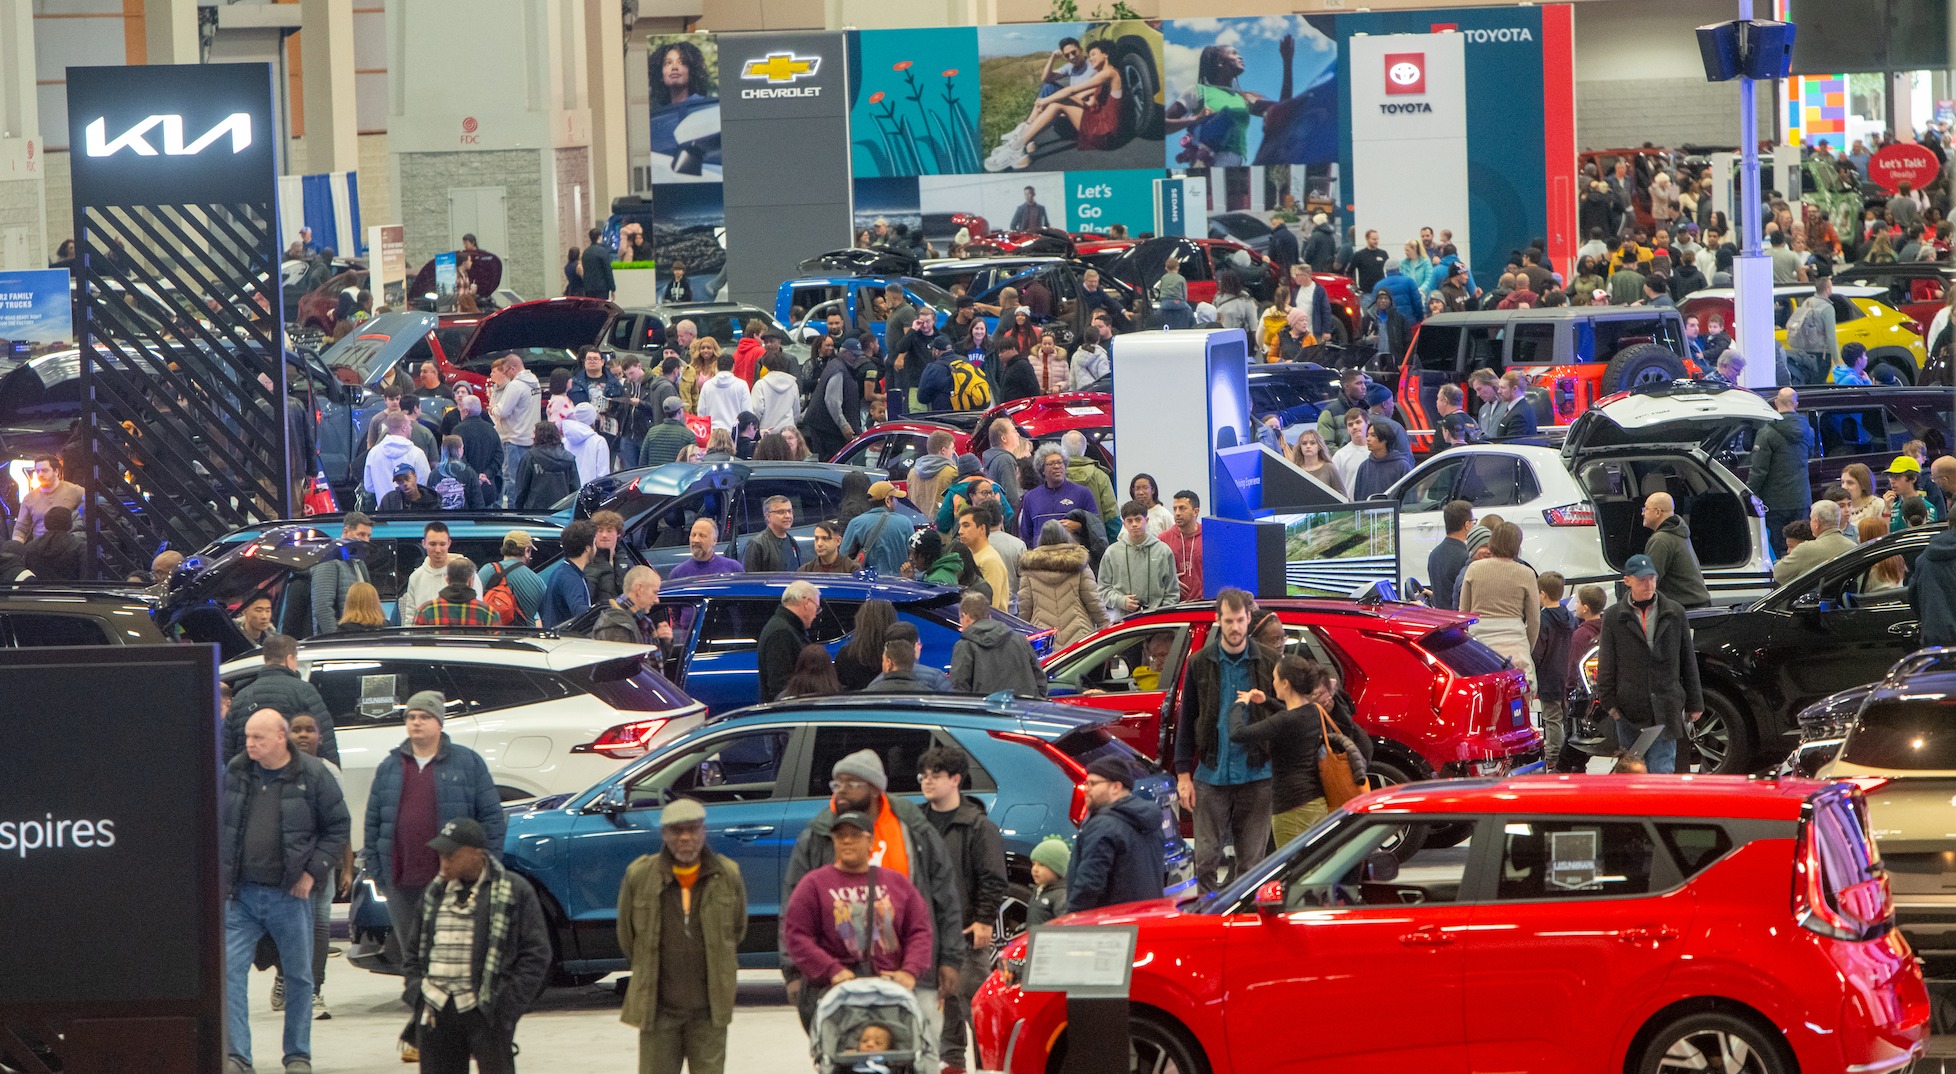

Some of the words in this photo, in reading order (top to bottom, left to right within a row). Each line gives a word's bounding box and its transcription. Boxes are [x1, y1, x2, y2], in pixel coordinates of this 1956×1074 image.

[1464, 27, 1533, 43] TOYOTA
[741, 86, 822, 99] CHEVROLET
[1379, 102, 1432, 114] TOYOTA
[86, 112, 252, 157] KIA
[460, 135, 480, 144] FDC
[1879, 158, 1902, 169] Let's
[1903, 157, 1927, 168] Talk!
[1077, 183, 1112, 199] Let's
[1078, 204, 1102, 219] Go
[1171, 187, 1179, 222] SEDANS
[9, 292, 34, 300] FAMILY
[5, 301, 32, 309] TRUCKS
[0, 812, 116, 858] spires
